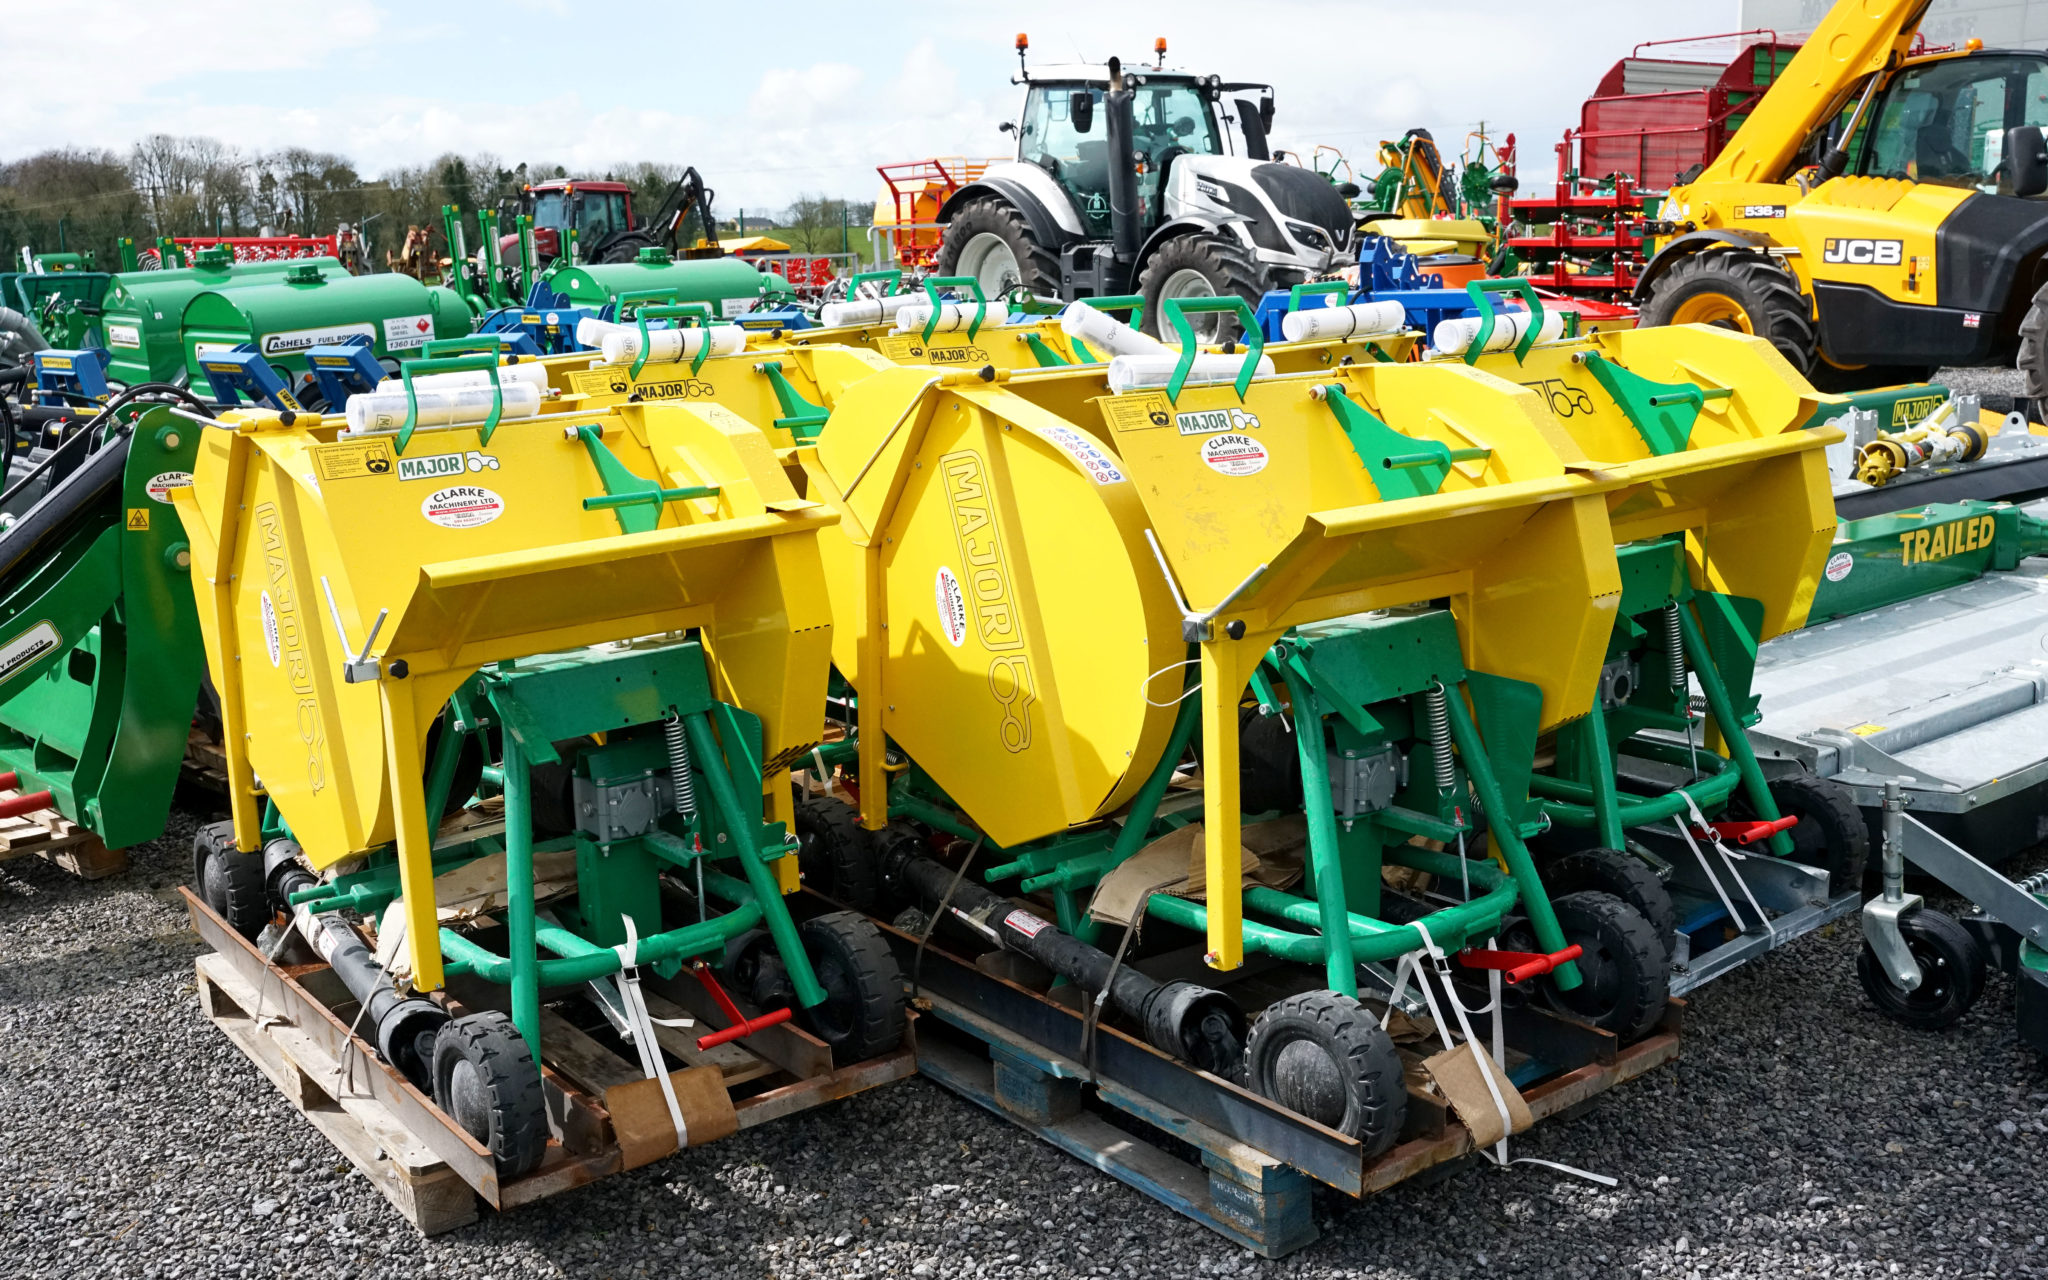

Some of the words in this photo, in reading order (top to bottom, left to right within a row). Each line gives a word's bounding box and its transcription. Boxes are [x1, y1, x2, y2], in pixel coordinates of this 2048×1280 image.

[1824, 239, 1901, 264] JCB
[266, 336, 312, 354] CASHELS
[317, 336, 335, 344] FUEL
[336, 332, 366, 341] BOW
[390, 341, 409, 349] 1360
[410, 338, 433, 347] Litr
[930, 349, 967, 362] MAJOR
[637, 383, 684, 399] MAJOR
[1894, 399, 1929, 423] MAJOR
[1178, 412, 1229, 432] MAJOR
[1207, 448, 1247, 457] MACHINERY
[1208, 435, 1251, 450] CLARKE
[401, 456, 461, 477] MAJOR
[429, 499, 478, 511] MACHINERY
[433, 487, 485, 503] CLARKE
[948, 461, 1012, 638] MAJOR
[1899, 515, 1996, 567] TRAILED
[261, 513, 307, 682] MAJOR
[950, 578, 965, 629] CLARKE
[6, 639, 45, 666] PRODUCTS
